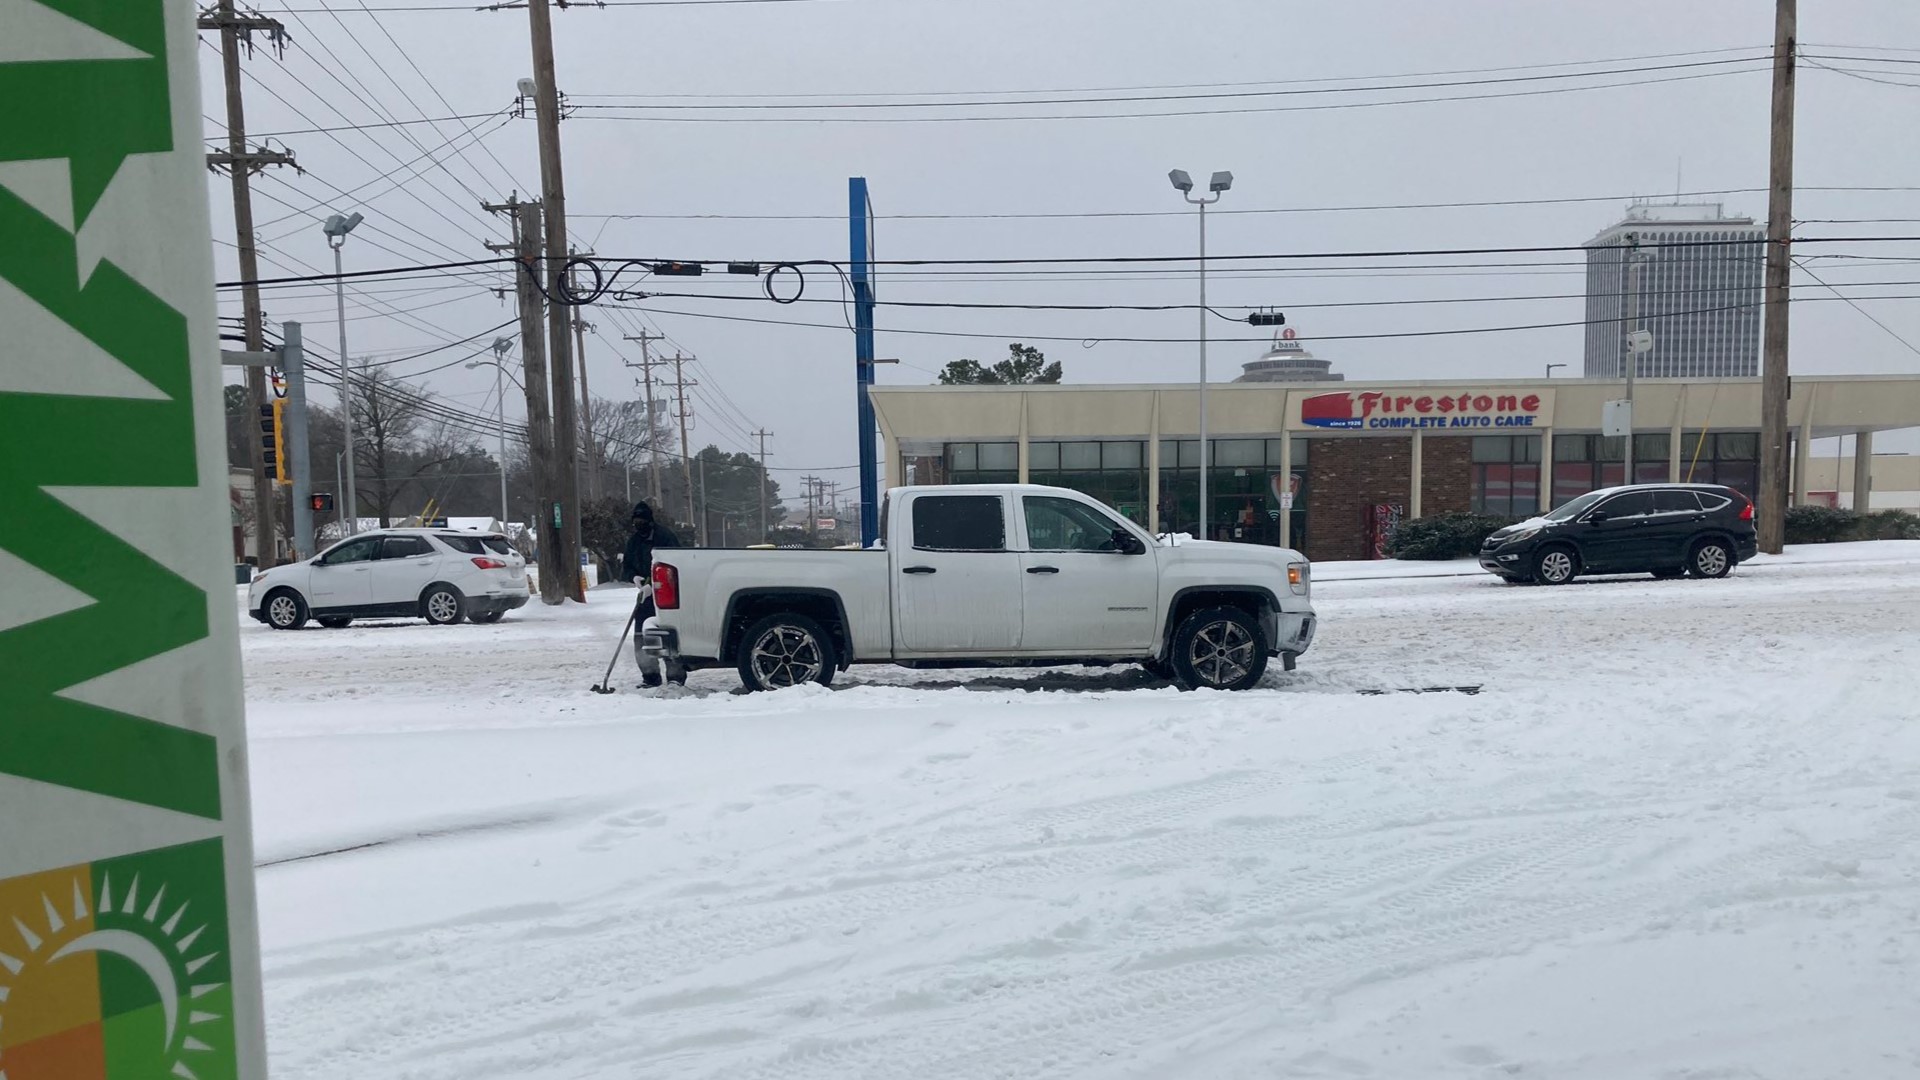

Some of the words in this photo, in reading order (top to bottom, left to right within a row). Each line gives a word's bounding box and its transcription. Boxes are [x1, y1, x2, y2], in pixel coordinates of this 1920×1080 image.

[1358, 391, 1540, 418] Firestone
[1369, 416, 1447, 428] COMPLETE
[1450, 416, 1491, 427] AUTO
[1495, 415, 1535, 427] CARE
